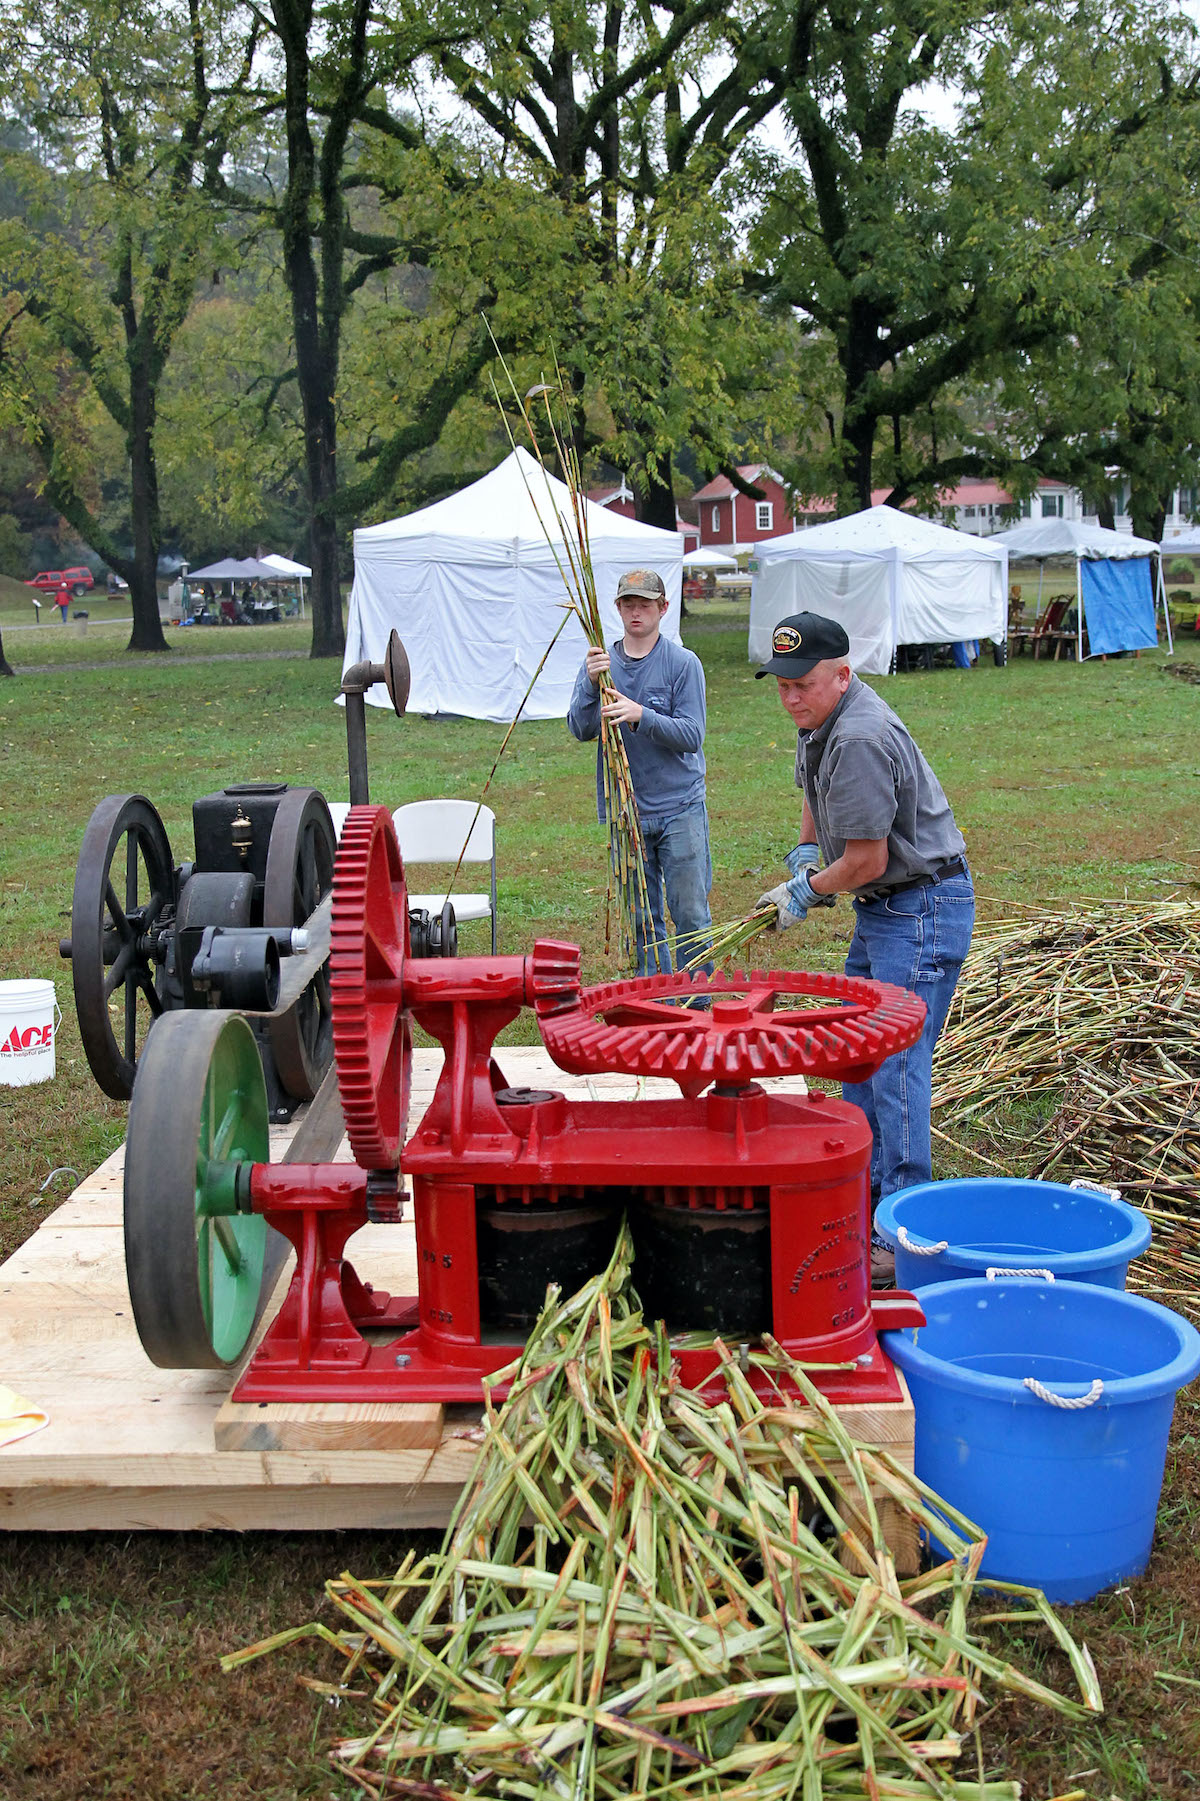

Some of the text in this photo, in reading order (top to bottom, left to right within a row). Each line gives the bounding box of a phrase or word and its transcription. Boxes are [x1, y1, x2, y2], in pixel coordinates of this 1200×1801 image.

[1, 1023, 52, 1052] ACE
[13, 1050, 37, 1058] helpful
[442, 1254, 453, 1269] 5
